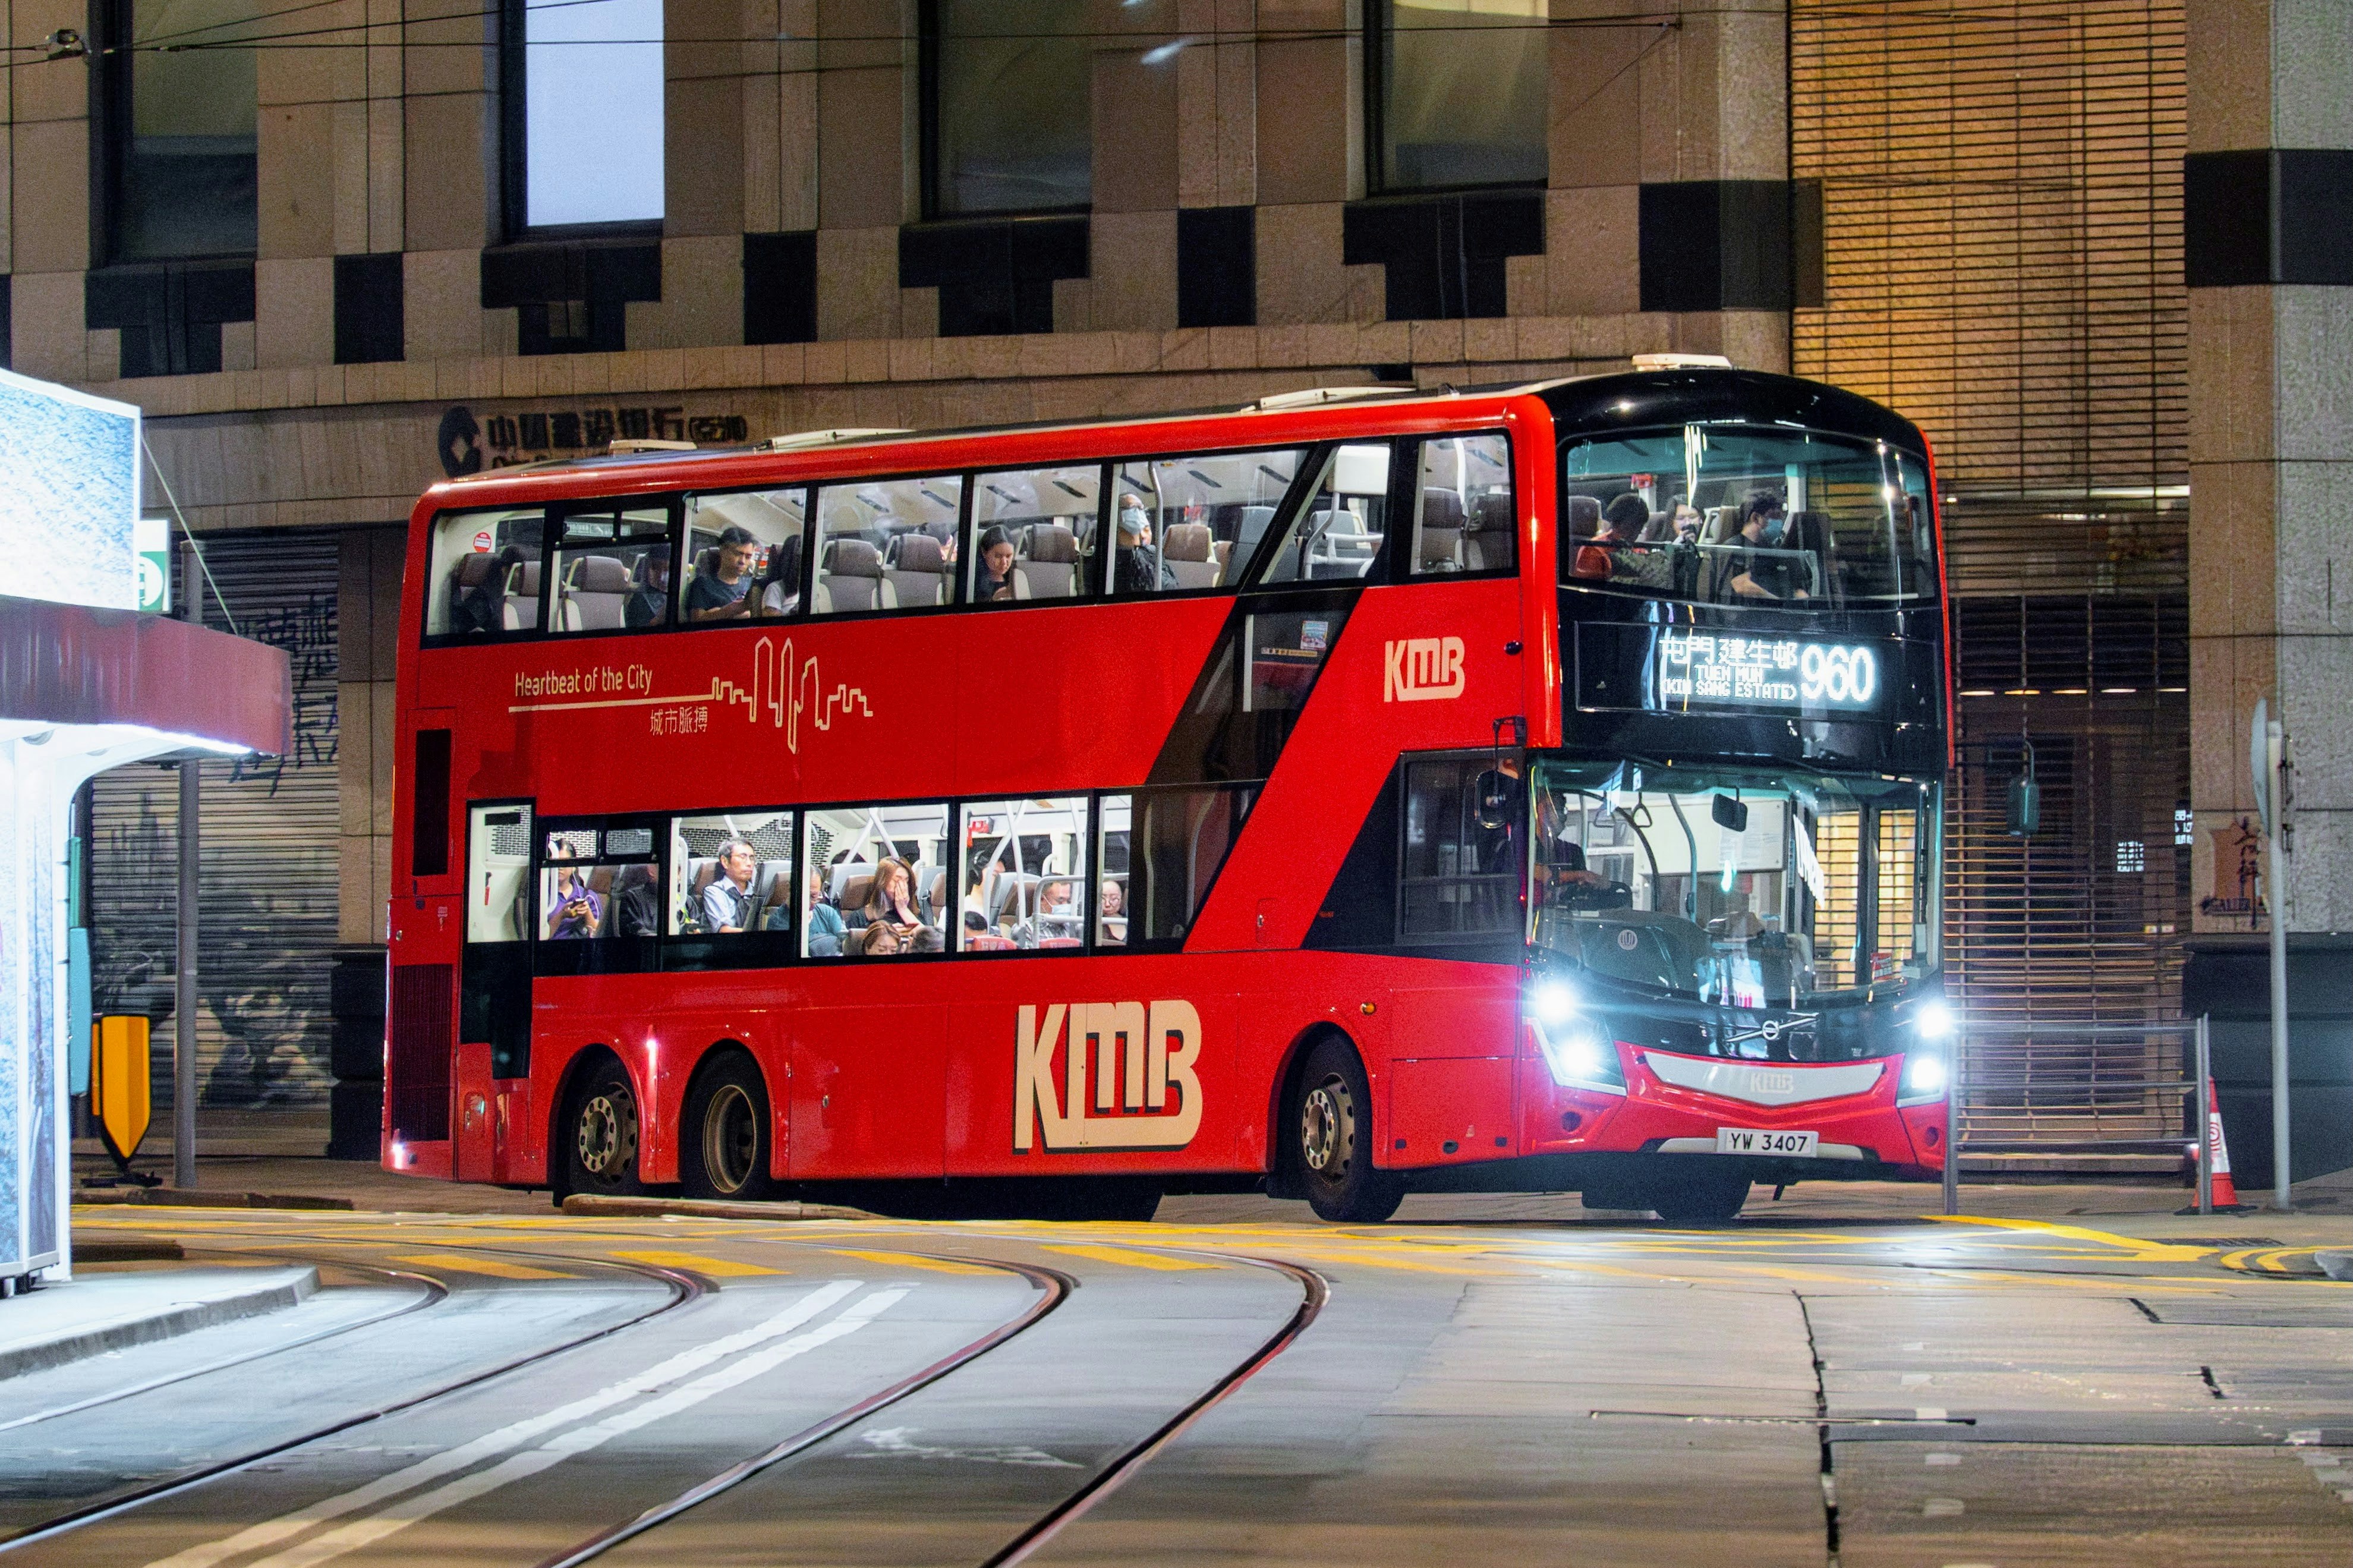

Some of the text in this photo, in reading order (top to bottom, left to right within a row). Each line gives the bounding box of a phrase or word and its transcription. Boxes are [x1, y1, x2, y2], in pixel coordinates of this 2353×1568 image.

[1659, 635, 1798, 669] 屯門建生邨
[515, 664, 653, 697] Heartbeat of the City
[1384, 637, 1464, 702] KMB
[1800, 644, 1875, 702] 960
[1695, 679, 1731, 697] SANG
[650, 706, 708, 736] 城市脈搏
[1012, 999, 1203, 1155] KMB
[1750, 1073, 1794, 1094] KMB
[1731, 1132, 1808, 1152] YW 3407
